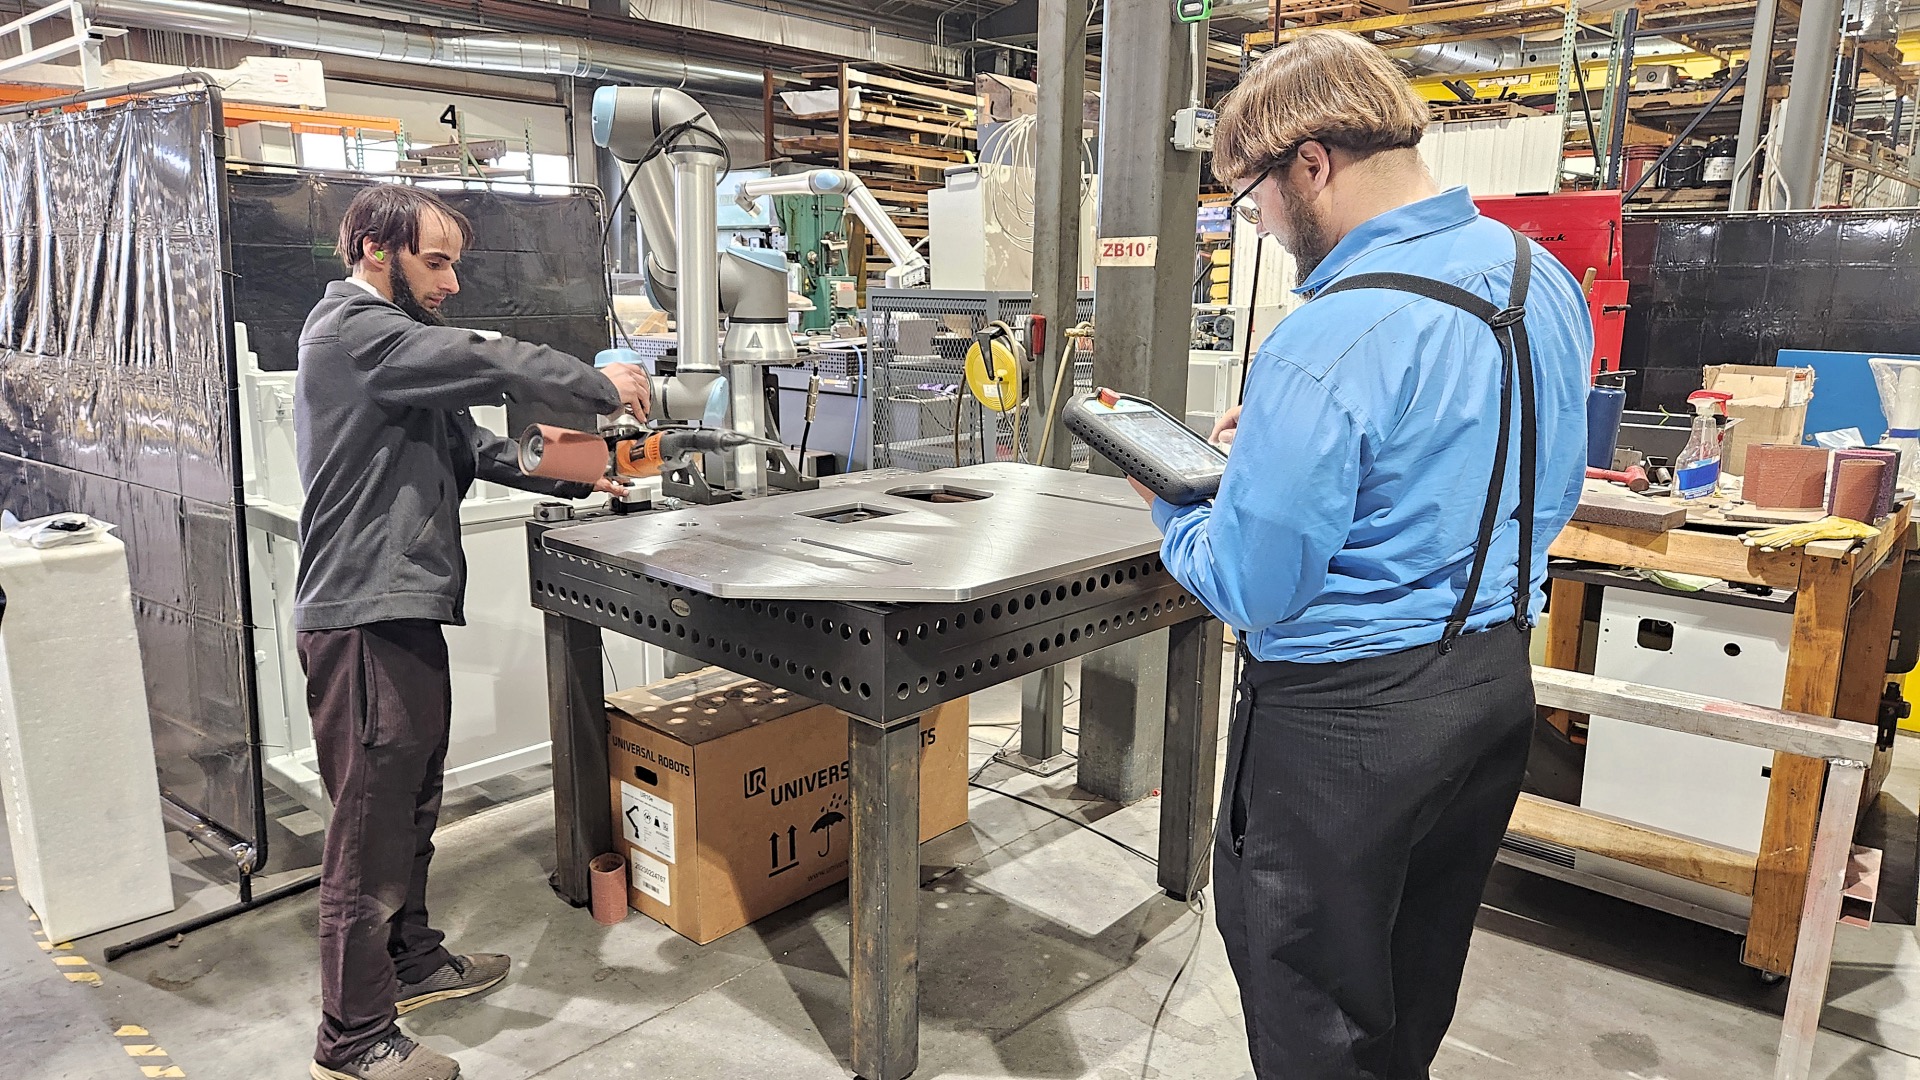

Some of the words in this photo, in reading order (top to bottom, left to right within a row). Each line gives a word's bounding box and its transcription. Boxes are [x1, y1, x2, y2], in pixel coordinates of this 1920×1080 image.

[1539, 76, 1560, 87] CAPACIT
[440, 104, 457, 129] 4
[1103, 242, 1145, 257] ZB10
[612, 735, 656, 763] UNIVERSAL
[658, 754, 690, 777] ROBOTS
[771, 760, 849, 807] UNIVERS
